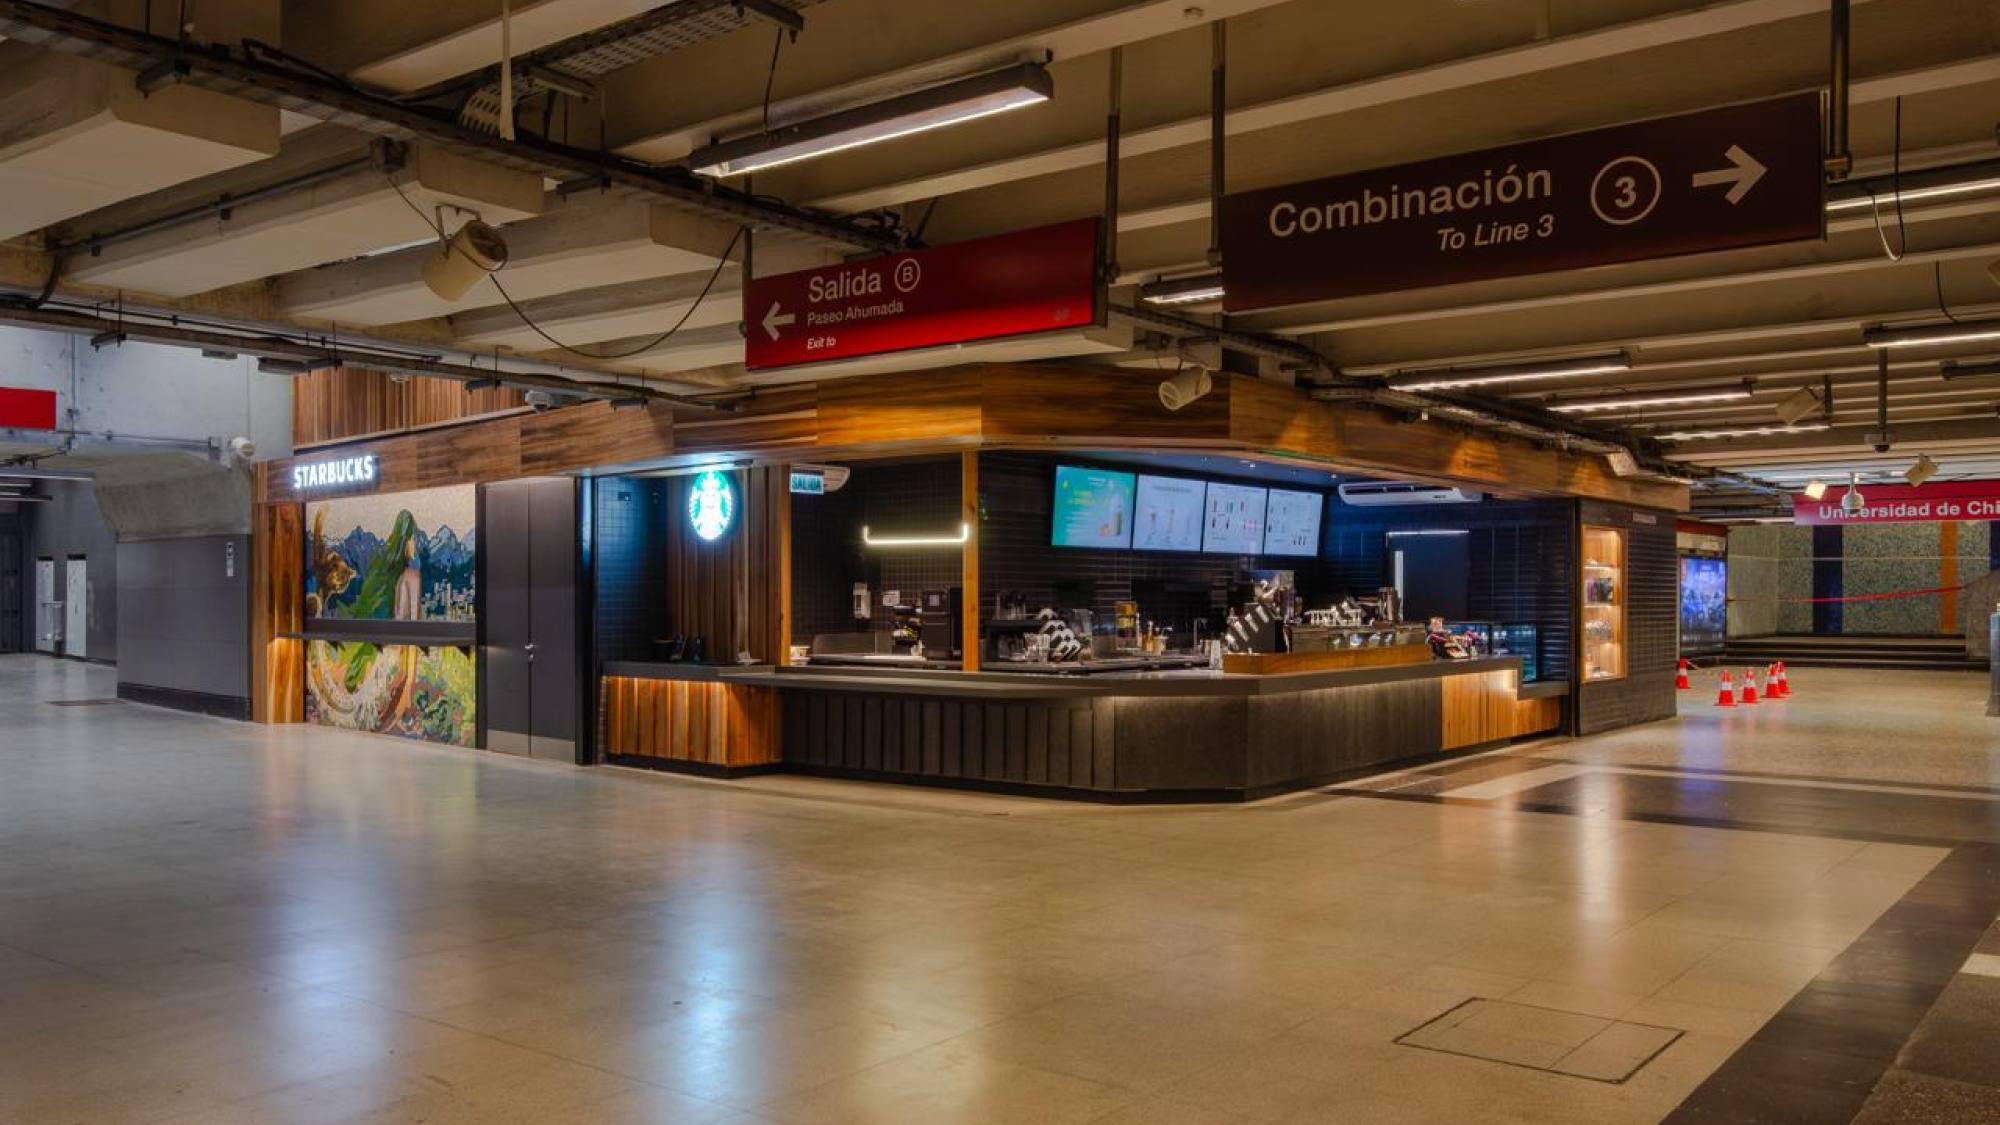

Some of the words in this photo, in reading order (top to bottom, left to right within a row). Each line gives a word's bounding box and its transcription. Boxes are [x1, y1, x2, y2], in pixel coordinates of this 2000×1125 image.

[1269, 165, 1552, 238] Combinación
[1614, 175, 1638, 209] 3
[1436, 227, 1465, 252] To
[1474, 219, 1529, 247] Line
[1536, 213, 1554, 238] 3
[807, 267, 882, 303] Salida
[902, 266, 914, 283] B
[807, 311, 843, 327] Paseo
[845, 299, 904, 320] Ahumada
[807, 337, 825, 350] Exit
[826, 336, 837, 348] to
[294, 455, 373, 489] STARBUCKS
[1819, 502, 1931, 519] Unersidad
[1936, 502, 1961, 517] de
